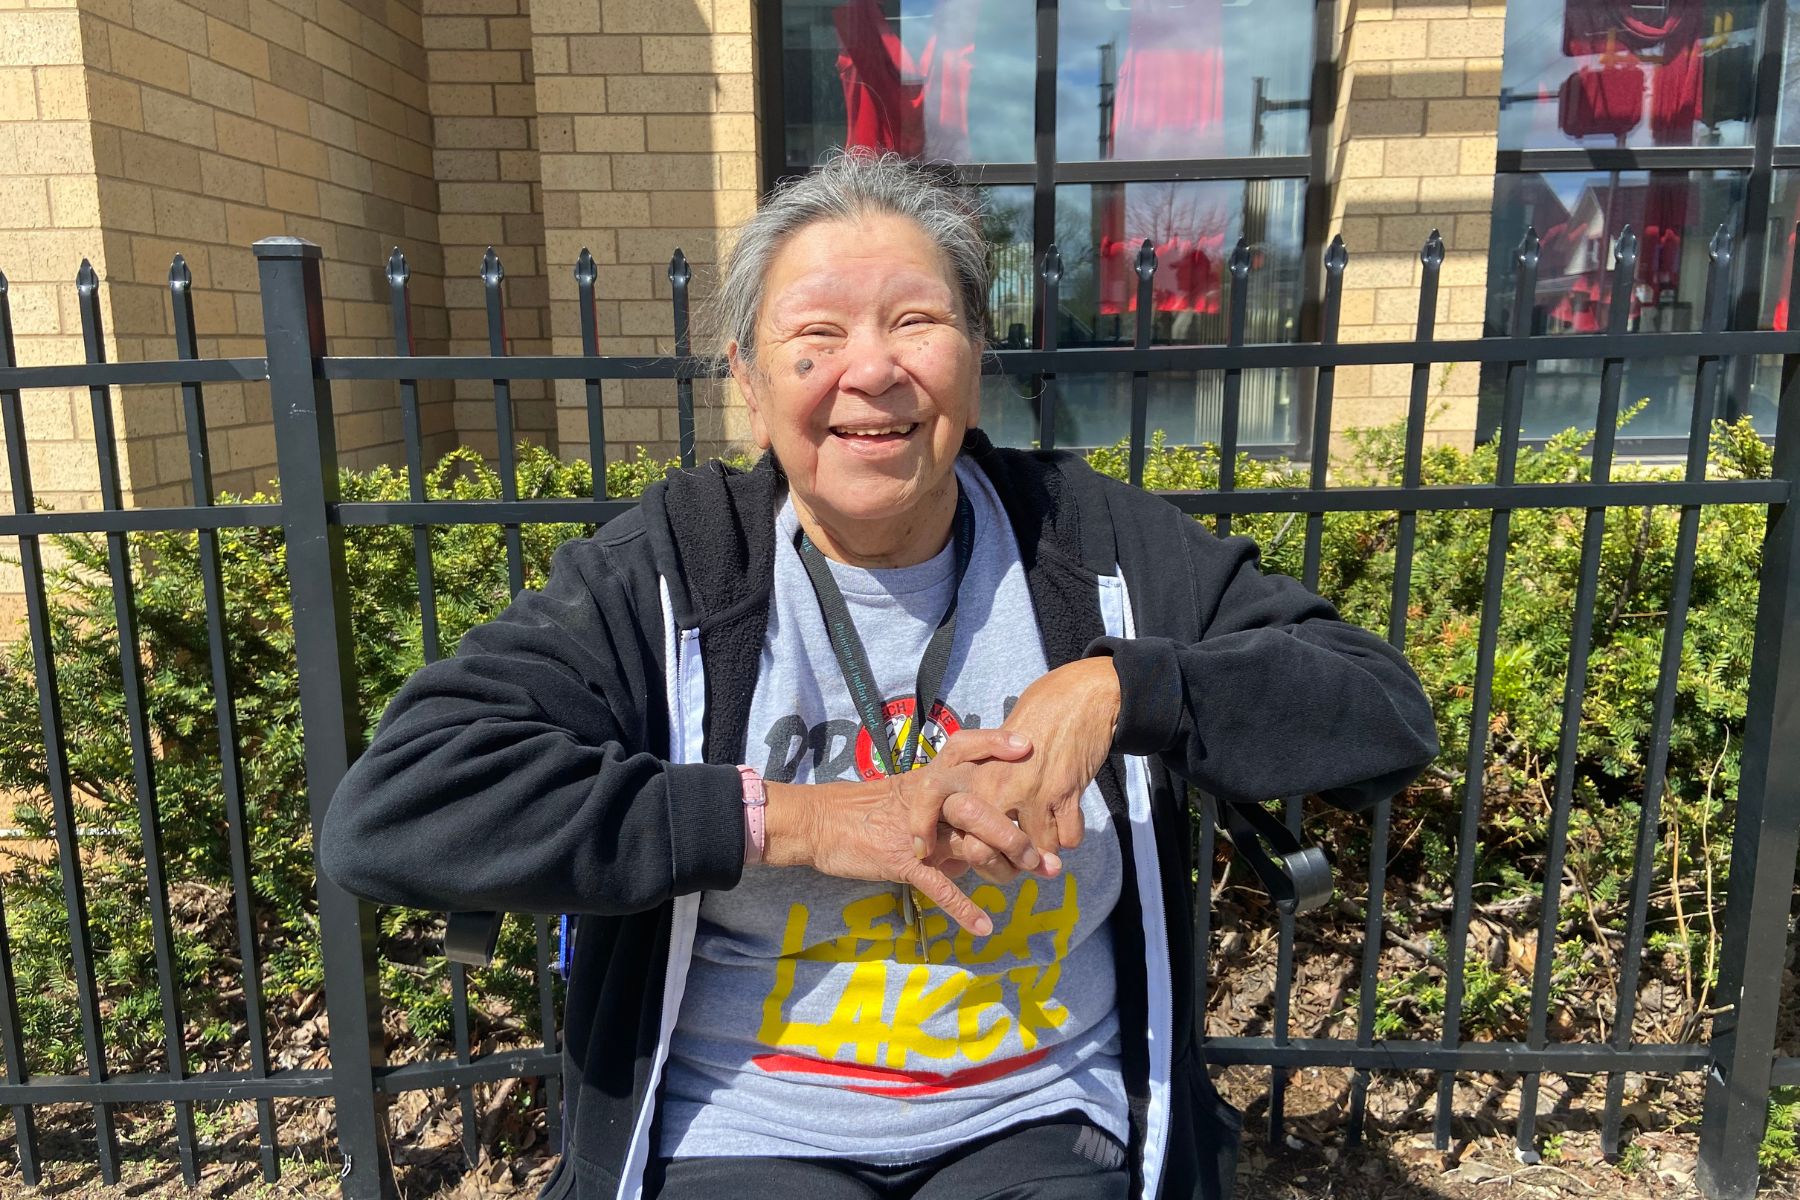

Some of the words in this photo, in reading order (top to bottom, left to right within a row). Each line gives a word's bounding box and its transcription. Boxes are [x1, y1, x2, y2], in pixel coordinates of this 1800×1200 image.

[834, 623, 853, 660] Division
[847, 660, 860, 671] of
[853, 672, 868, 702] Indian
[865, 702, 880, 730] Work
[780, 872, 1080, 964] LEECH
[757, 957, 1069, 1069] LAKER
